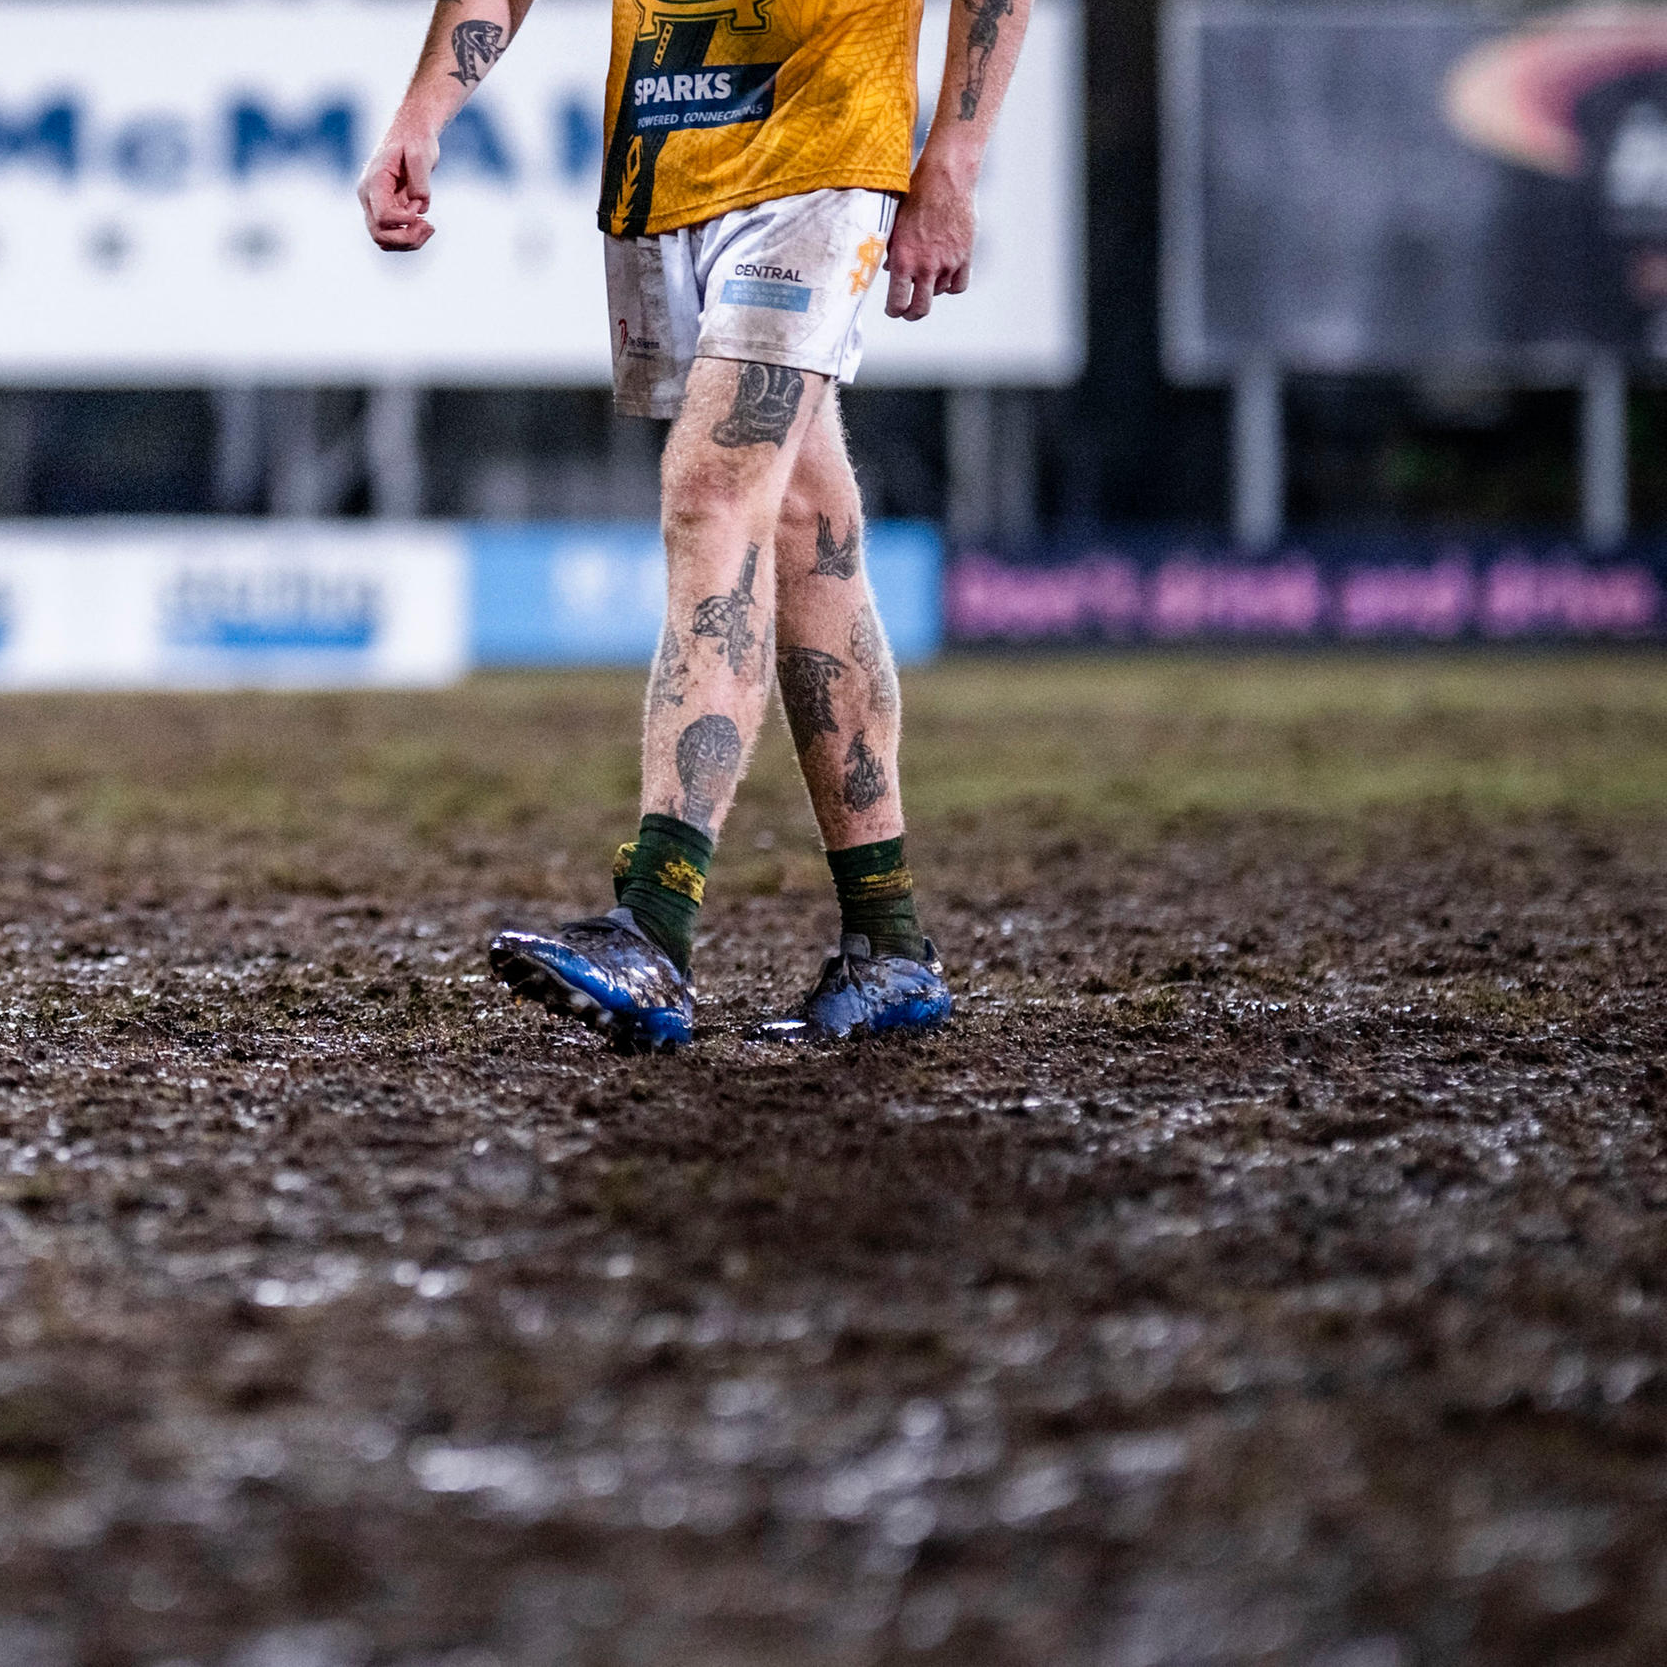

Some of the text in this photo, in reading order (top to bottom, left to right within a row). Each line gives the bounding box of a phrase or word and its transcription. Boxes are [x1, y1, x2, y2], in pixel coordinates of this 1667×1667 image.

[634, 72, 732, 106] SPARKS
[637, 103, 764, 130] POWERED CONNECTIONS
[735, 264, 803, 282] CENTRAL
